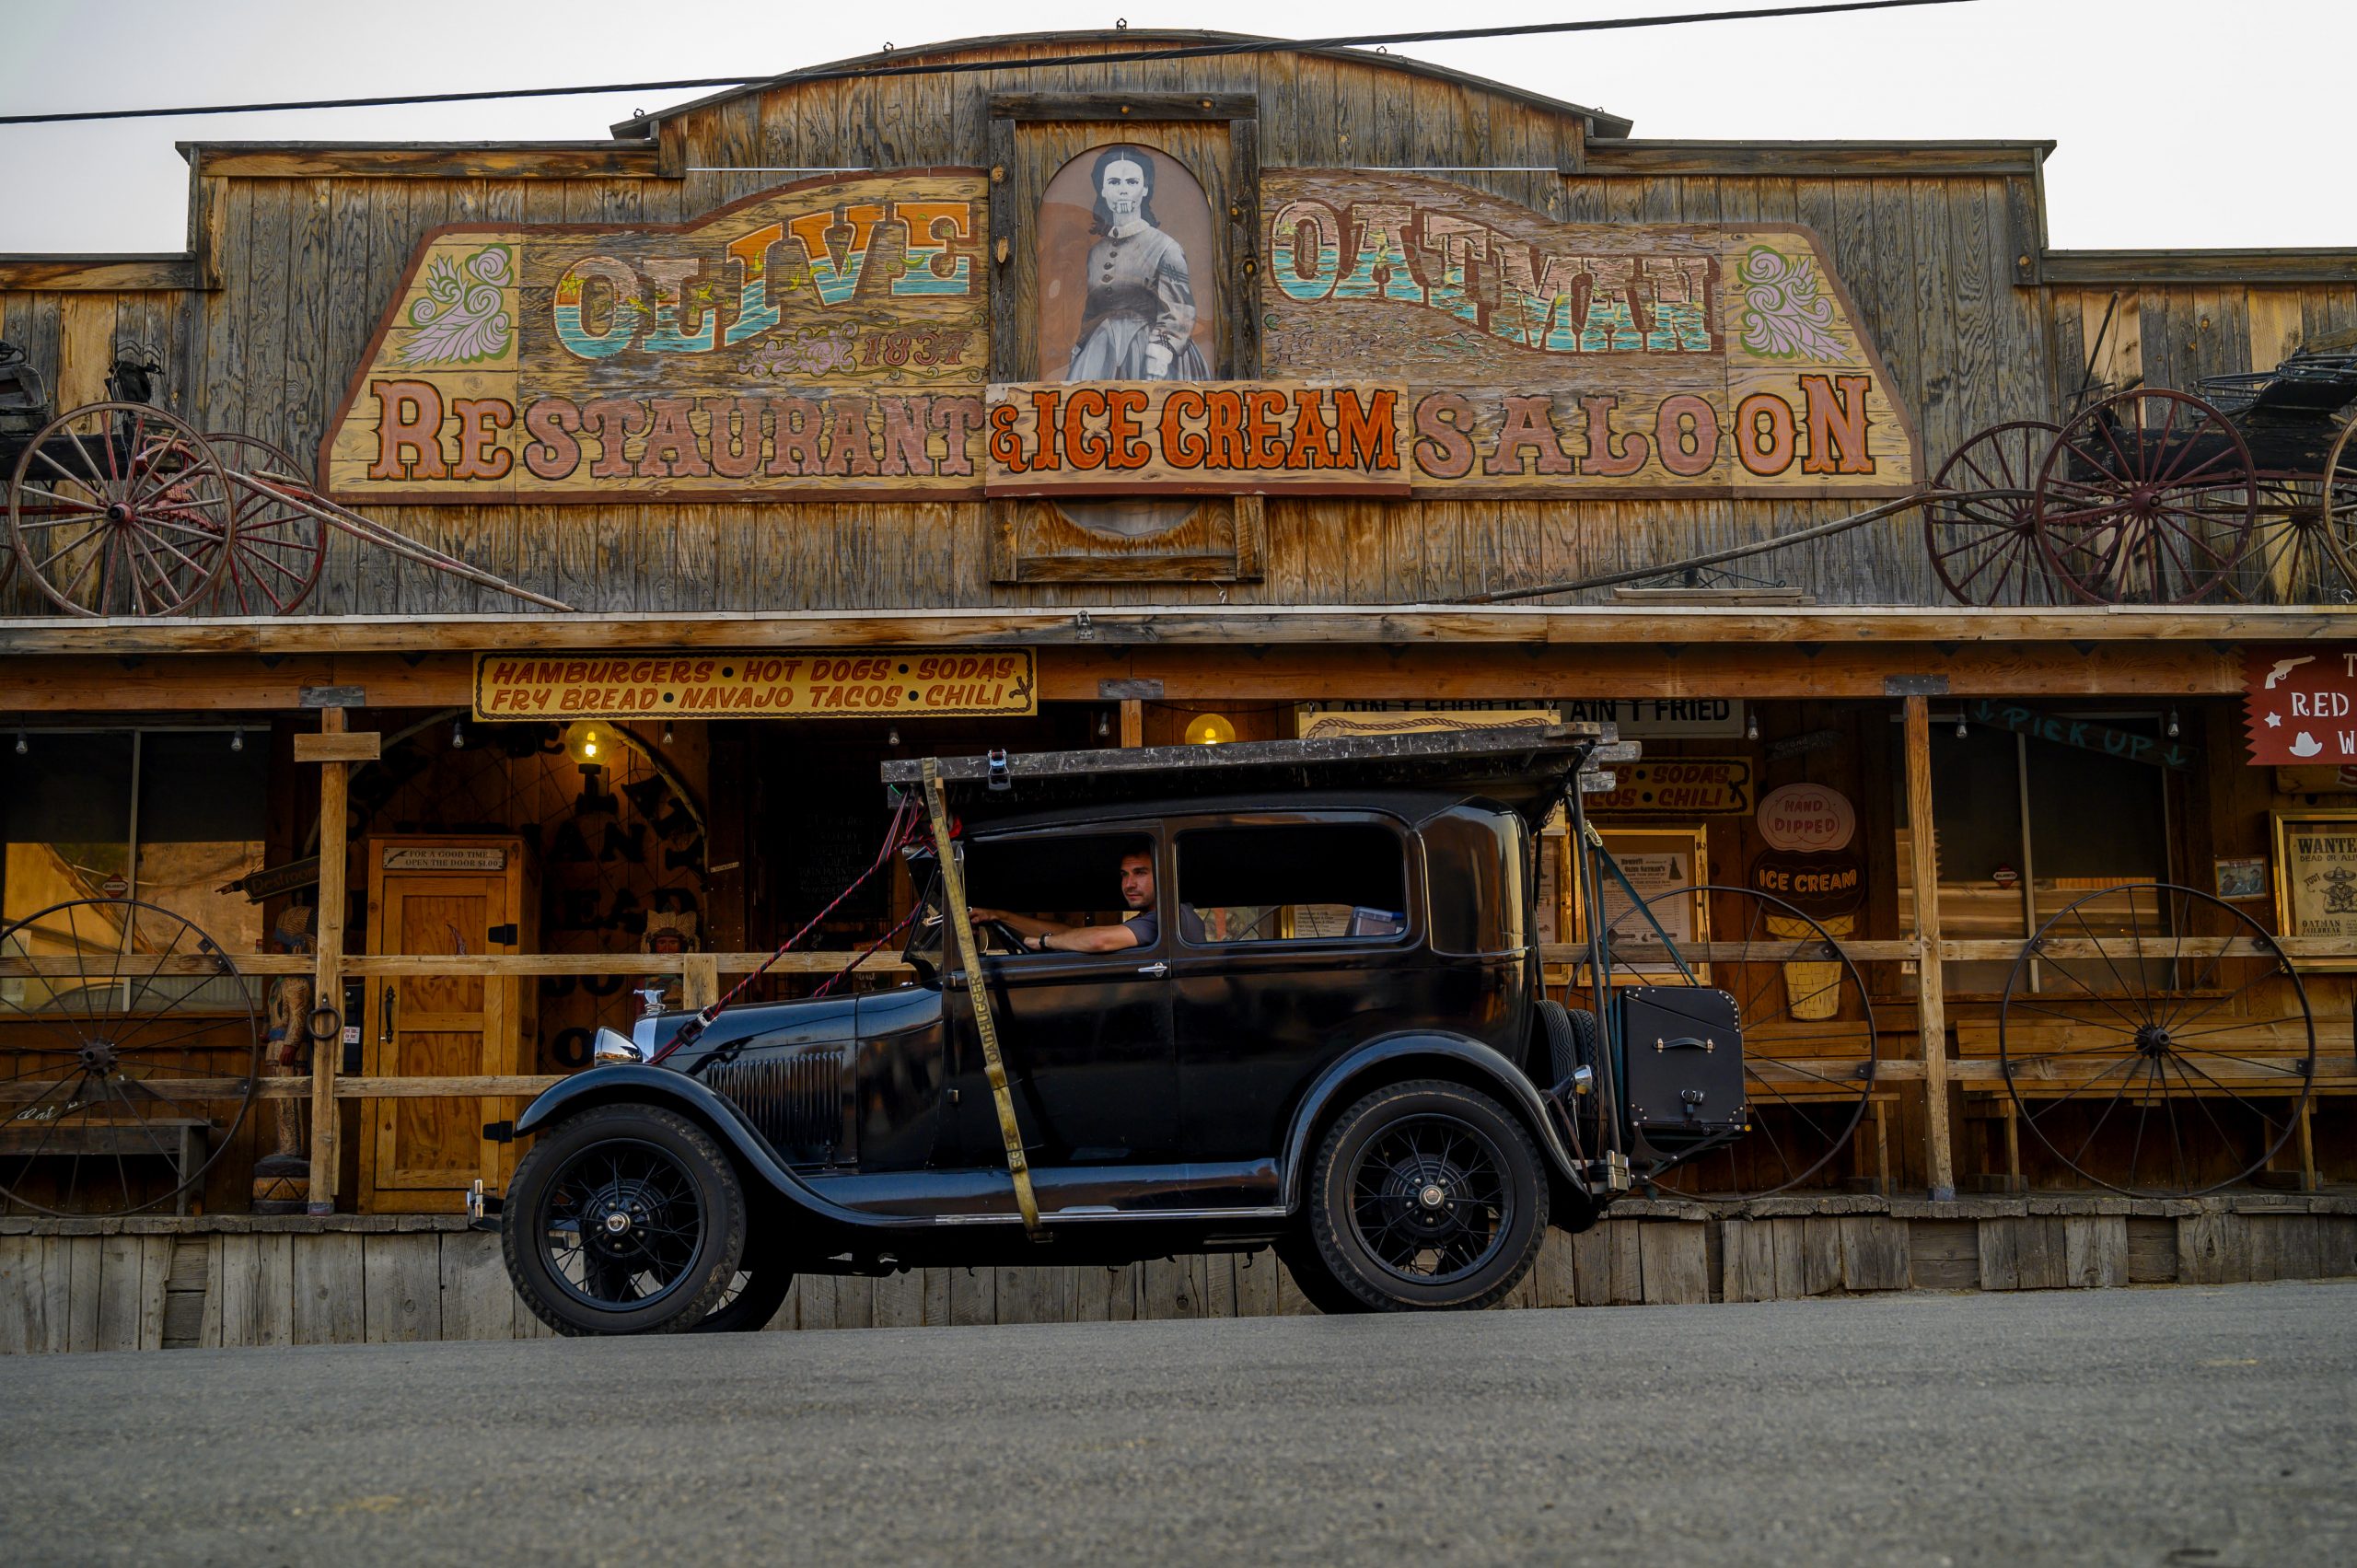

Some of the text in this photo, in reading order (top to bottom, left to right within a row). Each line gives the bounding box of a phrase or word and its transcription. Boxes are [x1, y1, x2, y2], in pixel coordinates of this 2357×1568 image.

[552, 202, 979, 361] OLIVE
[1269, 199, 1724, 355] OATMAN
[861, 331, 973, 366] 1837
[369, 379, 985, 481] RESTAURANT
[990, 388, 1401, 474] & ICE CREAM
[1413, 374, 1877, 480] SALOON
[492, 656, 1016, 685] HAMBURGERS HOT DOGS SODAS
[491, 683, 1004, 712] FRY BREAD NAVAJO TACOS CHILI
[1655, 699, 1730, 721] FRIED
[2291, 691, 2349, 717] RED
[2001, 707, 2154, 760] PICK UP
[1652, 765, 1731, 784] SODAS
[1658, 788, 1724, 807] CHILI
[1784, 800, 1823, 812] HAND
[1774, 818, 1836, 834] DIPPED
[2297, 838, 2357, 854] WANTE
[1759, 868, 1858, 892] ICE CREAM
[2302, 920, 2340, 928] OATMAN
[982, 1033, 1001, 1063] OAD
